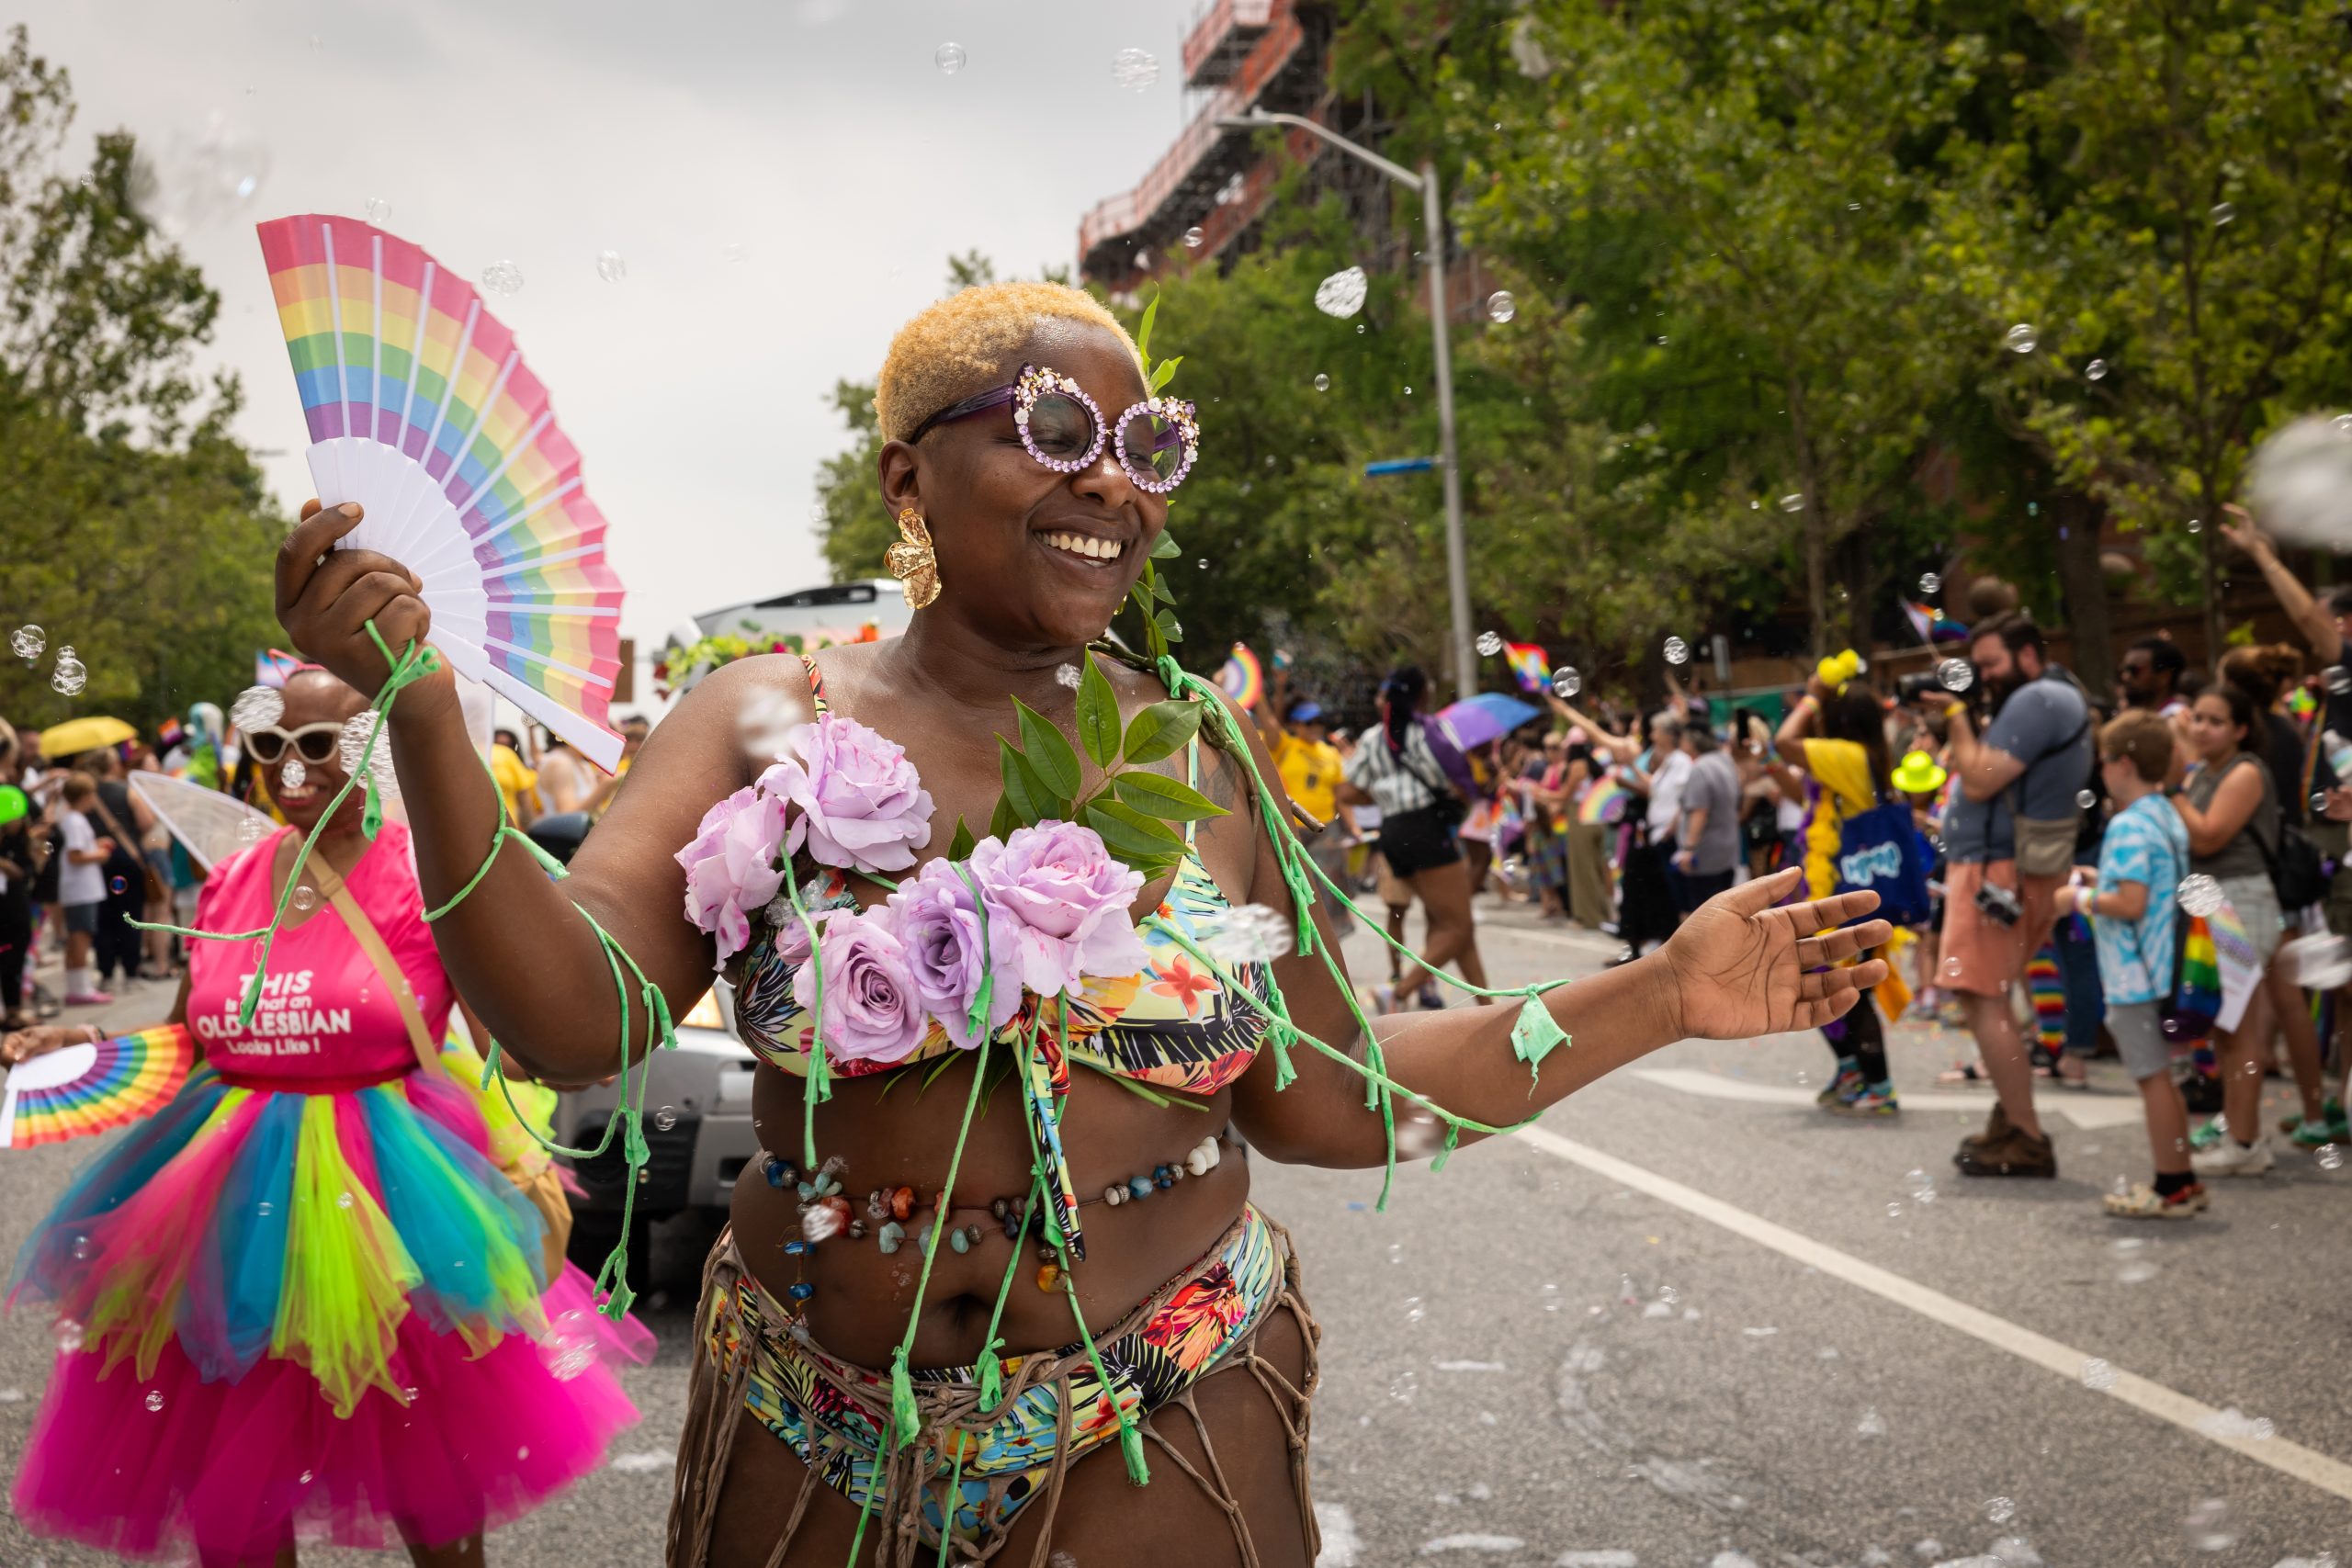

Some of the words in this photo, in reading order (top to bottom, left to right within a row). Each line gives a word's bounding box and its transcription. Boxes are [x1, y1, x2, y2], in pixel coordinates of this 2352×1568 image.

[240, 970, 313, 997] THIS
[289, 996, 311, 1010] an
[197, 1015, 243, 1039] OLD
[250, 1009, 352, 1036] LESBIAN
[226, 1039, 273, 1055] Looks
